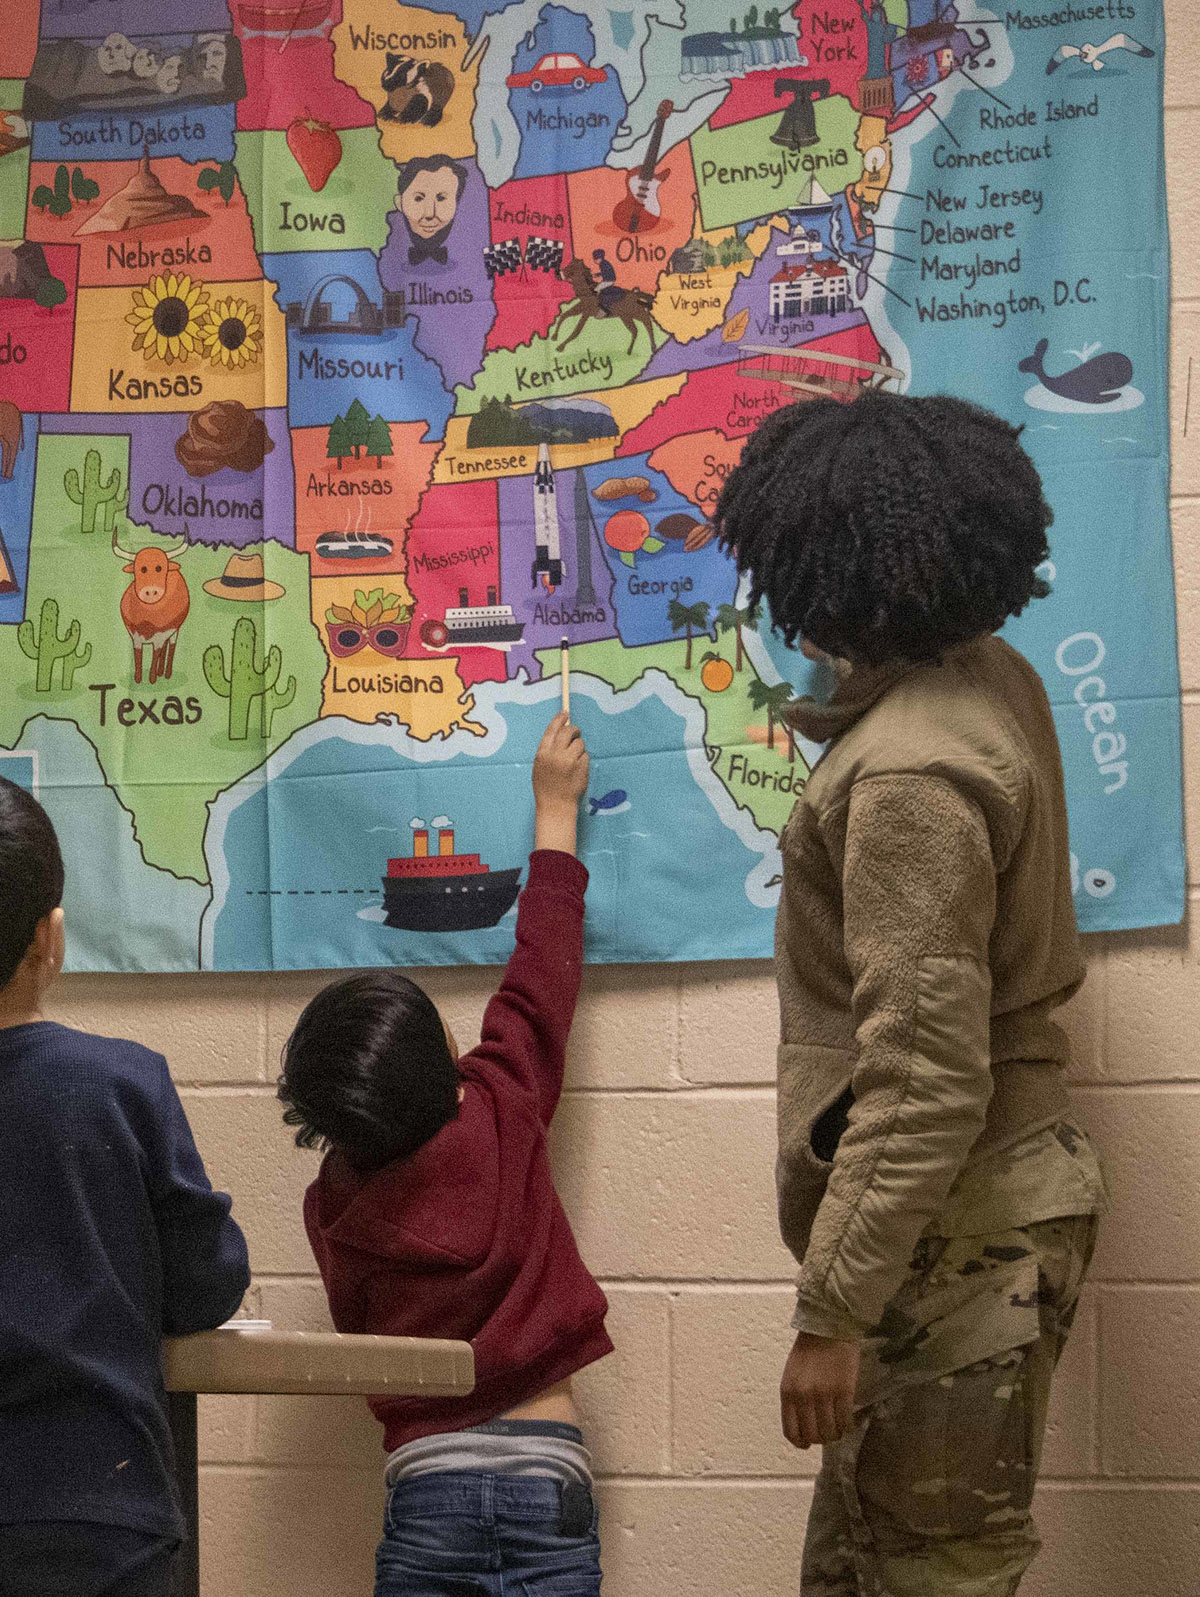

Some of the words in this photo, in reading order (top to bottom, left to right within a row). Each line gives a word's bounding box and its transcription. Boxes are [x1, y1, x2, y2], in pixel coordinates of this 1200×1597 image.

[811, 14, 855, 34] New
[1006, 3, 1136, 30] Massachusetts
[350, 26, 456, 50] Wisconsin
[811, 39, 857, 62] York
[526, 111, 610, 138] Michigan
[980, 108, 1037, 129] Rhode
[1045, 95, 1099, 122] Island
[58, 121, 123, 146] South
[130, 121, 205, 146] Dakota
[933, 136, 1052, 168] Connecticut
[701, 149, 849, 189] Pennsylvania
[926, 189, 966, 212] New
[978, 185, 1043, 214] Jersey
[279, 202, 346, 234] Iowa
[493, 201, 564, 228] Indiana
[921, 219, 1016, 245] Delaware
[107, 237, 212, 269] Nebraska
[616, 236, 666, 263] Ohio
[679, 274, 712, 289] West
[921, 249, 1021, 289] Maryland
[408, 282, 474, 305] Illinois
[670, 296, 721, 316] Virginia
[916, 290, 1045, 327] Washington,
[1054, 278, 1097, 306] D.C.
[755, 318, 814, 343] Virginia
[299, 348, 404, 380] Missouri
[515, 348, 613, 391] Kentucky
[108, 369, 202, 400] Kansas
[734, 389, 780, 409] North
[445, 454, 527, 475] Tennessee
[703, 454, 736, 479] Sou
[306, 473, 393, 497] Arkansas
[142, 484, 264, 519] Oklahoma
[414, 542, 494, 574] Mississippi
[628, 574, 693, 598] Georgia
[533, 603, 606, 626] Alabama
[332, 672, 444, 694] Louisiana
[88, 683, 203, 727] Texas
[1055, 631, 1129, 795] Ocean
[728, 754, 805, 796] Florida
